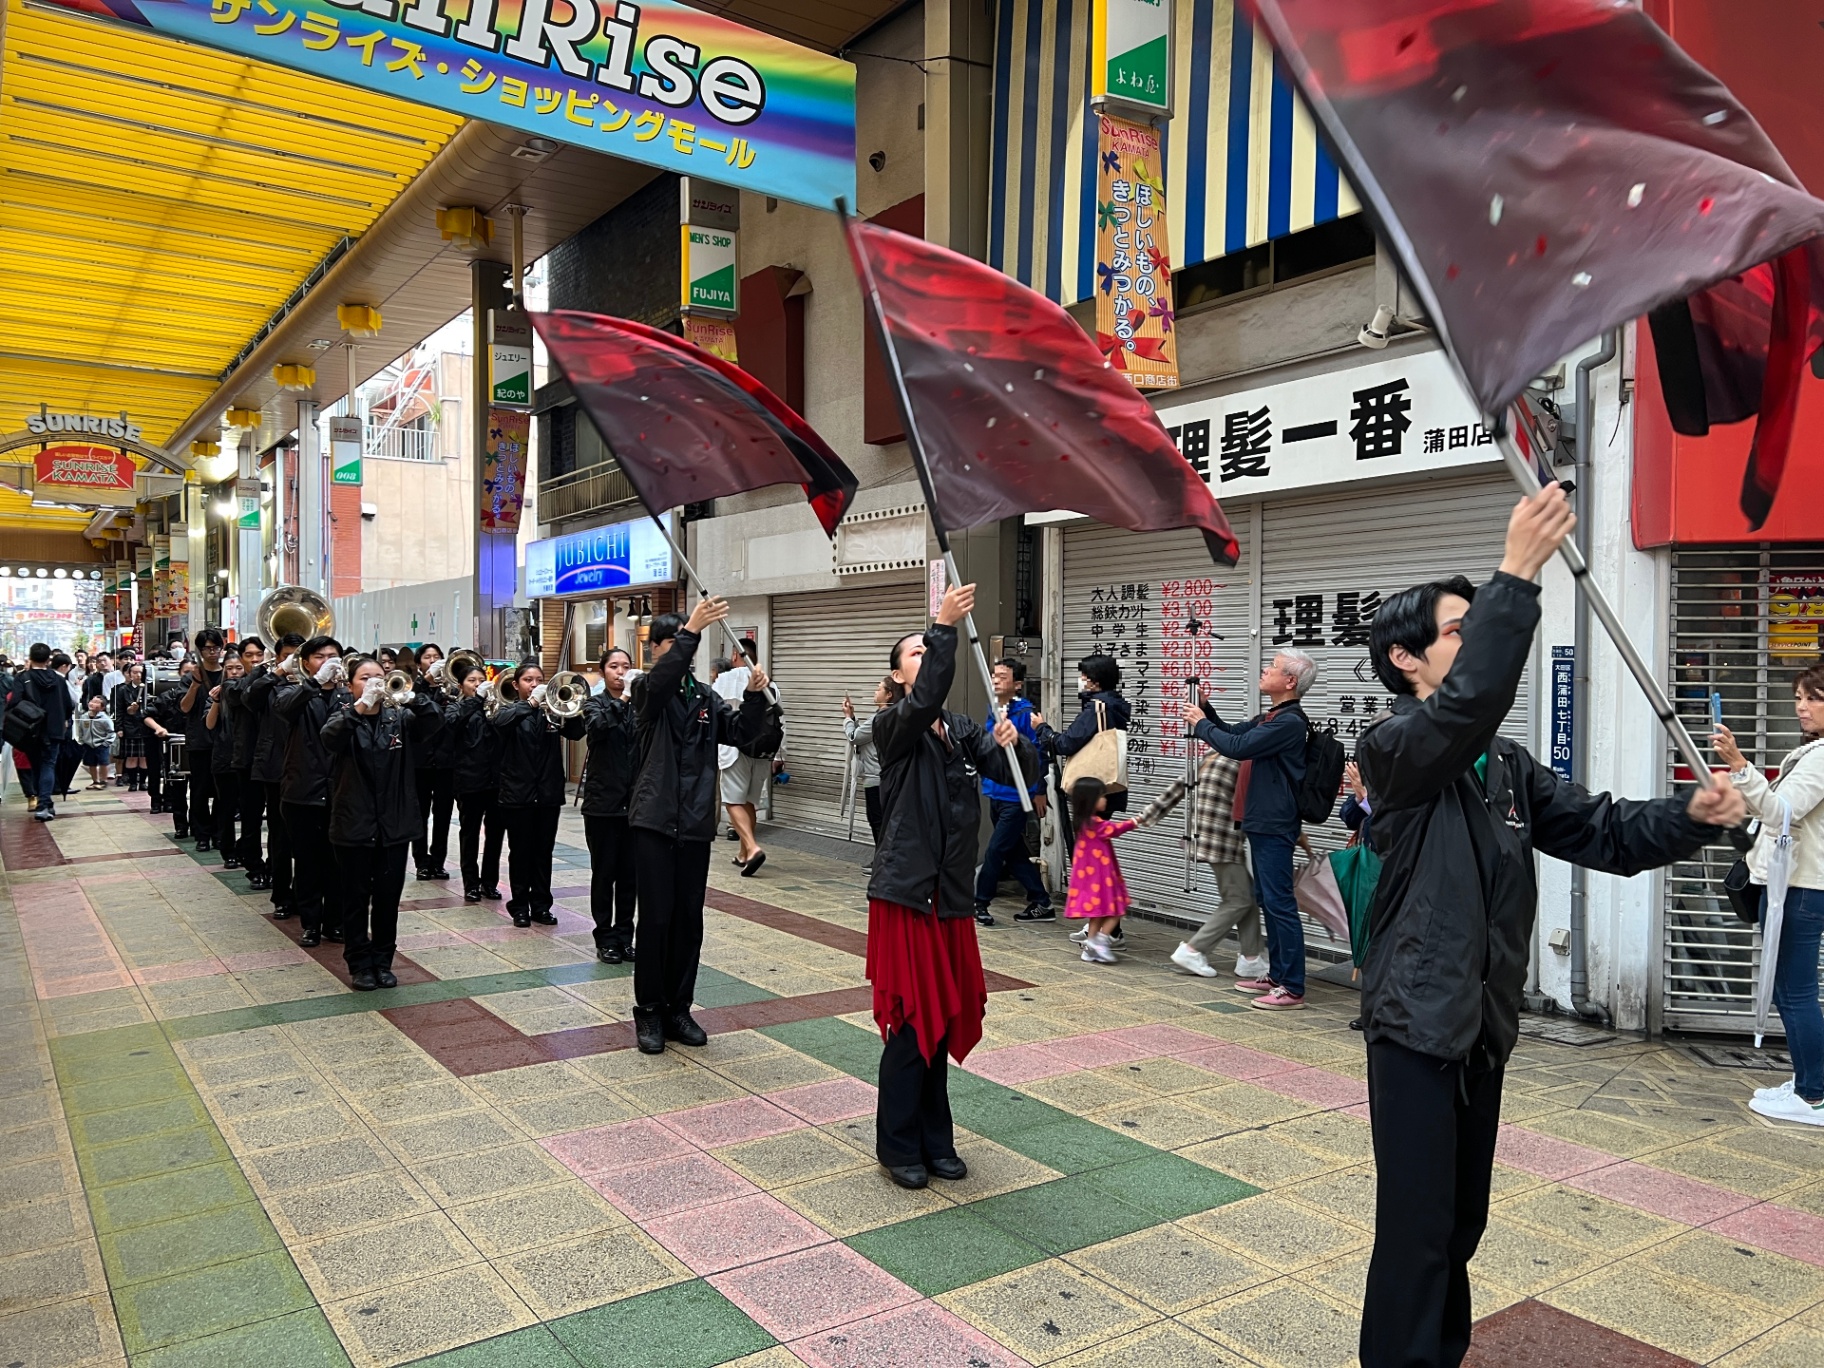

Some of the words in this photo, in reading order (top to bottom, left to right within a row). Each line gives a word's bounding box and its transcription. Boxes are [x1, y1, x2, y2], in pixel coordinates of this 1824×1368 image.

[320, 0, 767, 125] nRise
[1101, 117, 1158, 151] SunRise
[1112, 141, 1150, 159] KAMATA
[690, 231, 711, 245] MEN'S
[712, 235, 732, 249] SHOP
[1134, 182, 1157, 306] ほしいもの、
[693, 287, 731, 302] FUJIYA
[686, 319, 734, 337] SunRise
[494, 352, 527, 363] ジュエリー
[496, 388, 526, 400] 紀のや
[25, 412, 143, 444] SUNRISE
[1422, 423, 1494, 455] 蒲田店
[52, 460, 118, 475] SUNRISE
[52, 470, 118, 485] KAMATA
[557, 531, 626, 572] JUBICHI
[574, 568, 604, 585] Jewelry
[1091, 583, 1149, 601] 大人調髪
[1091, 622, 1149, 638] 中学生
[1557, 671, 1568, 745] 西蒲田七丁目
[1553, 746, 1570, 761] 50
